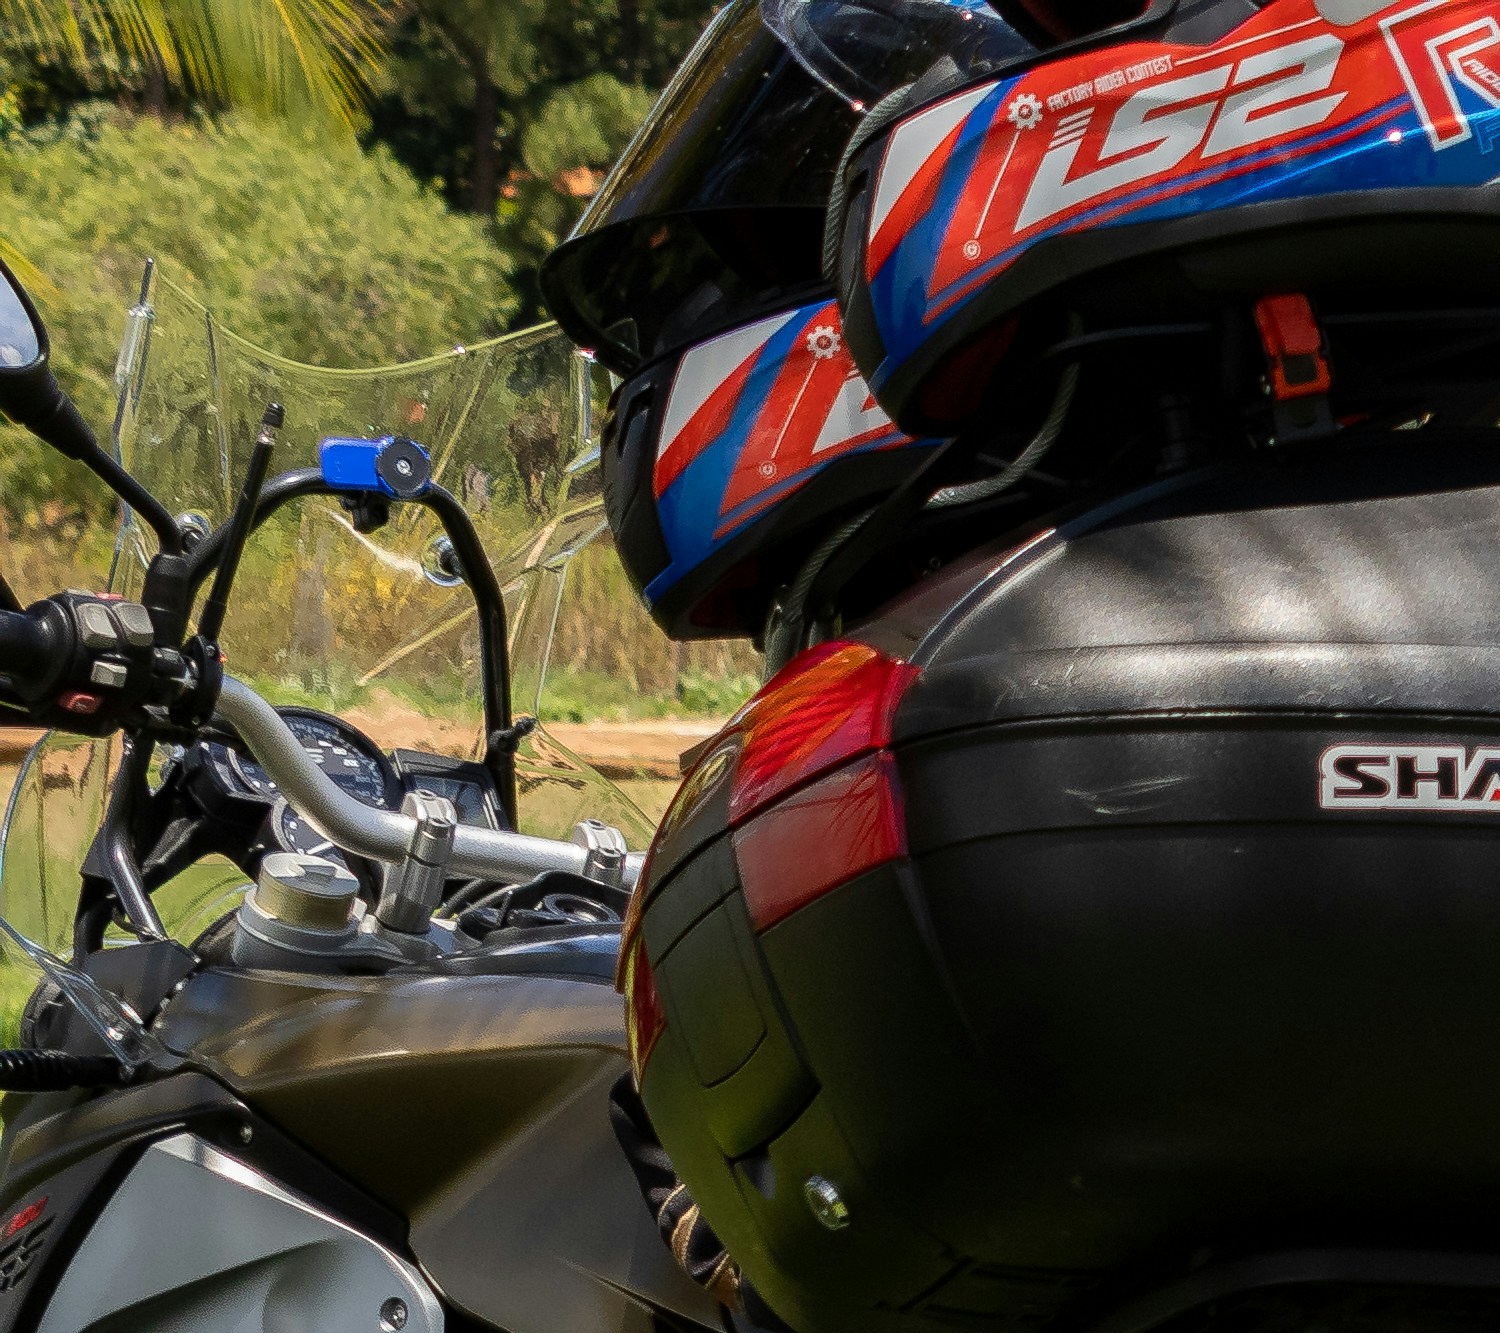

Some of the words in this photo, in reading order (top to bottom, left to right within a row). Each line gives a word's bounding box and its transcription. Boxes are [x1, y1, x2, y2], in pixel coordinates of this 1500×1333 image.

[1013, 32, 1348, 234] LS2
[1047, 81, 1094, 112] FACTORY
[1093, 69, 1127, 98] RIDER
[1125, 55, 1173, 85] CONTEST
